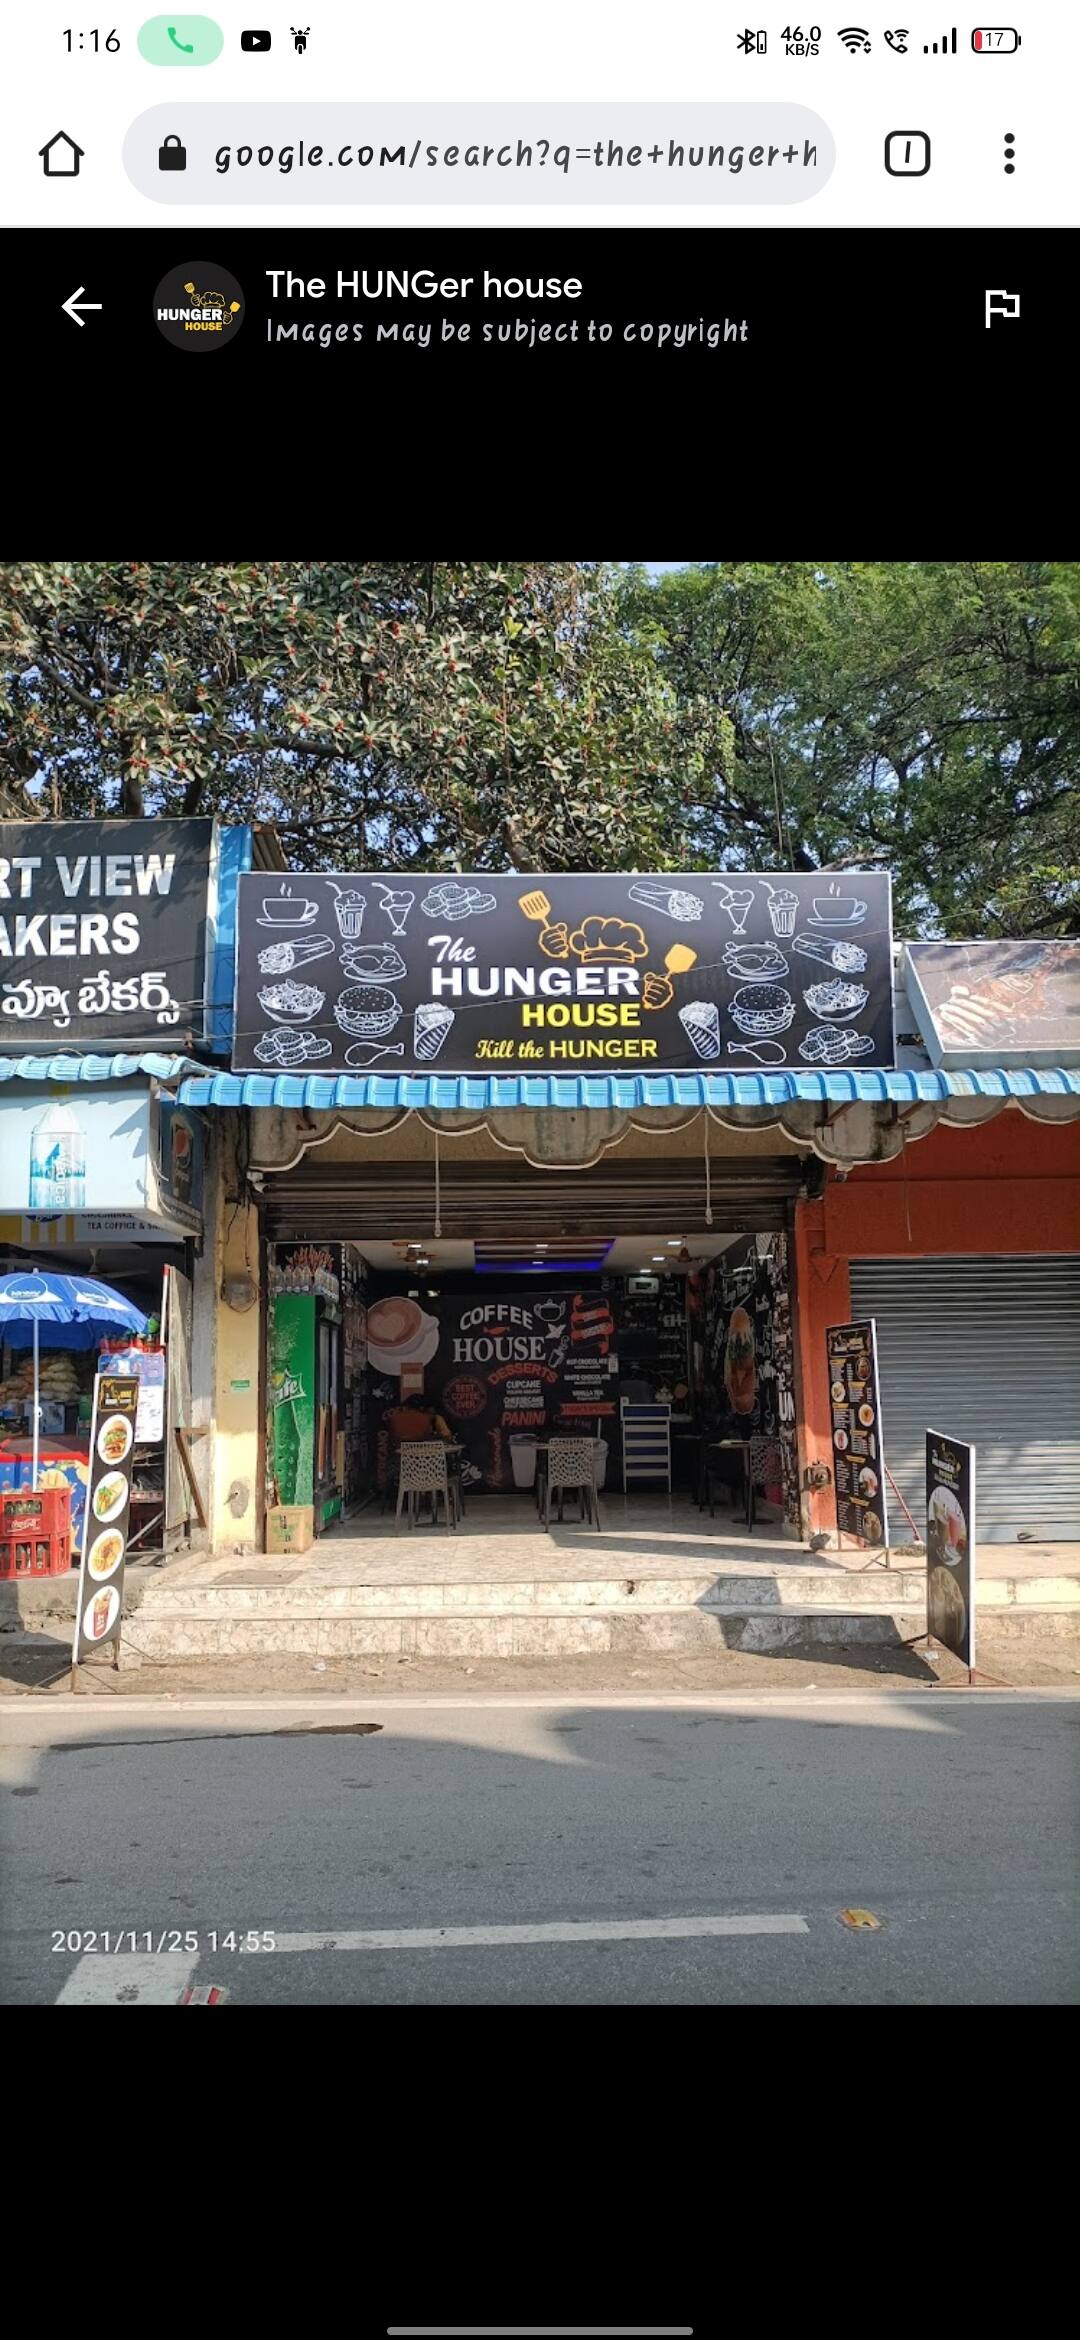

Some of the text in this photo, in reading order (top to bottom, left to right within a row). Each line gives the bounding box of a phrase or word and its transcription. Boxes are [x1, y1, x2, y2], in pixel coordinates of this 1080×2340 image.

[62, 29, 121, 53] 1:16
[780, 26, 822, 42] 46.0
[985, 32, 1004, 47] 17
[785, 43, 820, 57] KB/S
[266, 269, 583, 299] The HUNGer house
[157, 308, 222, 321] HUNGER
[184, 322, 222, 331] HOUSE
[376, 323, 432, 348] may
[441, 318, 471, 342] be
[482, 318, 579, 348] subject
[587, 319, 613, 342] to
[623, 317, 748, 348] copyright
[56, 854, 176, 897] VIEW
[427, 935, 476, 963] The
[430, 966, 641, 996] HUNGER
[522, 1003, 641, 1027] HOUSE
[475, 1039, 658, 1058] Kill the HUNGER
[460, 1304, 534, 1331] COFFEE
[452, 1336, 546, 1362] HOUSE
[487, 1362, 558, 1386] DESSERTS
[506, 1379, 542, 1389] CUPCAKE
[501, 1410, 546, 1426] PANINI
